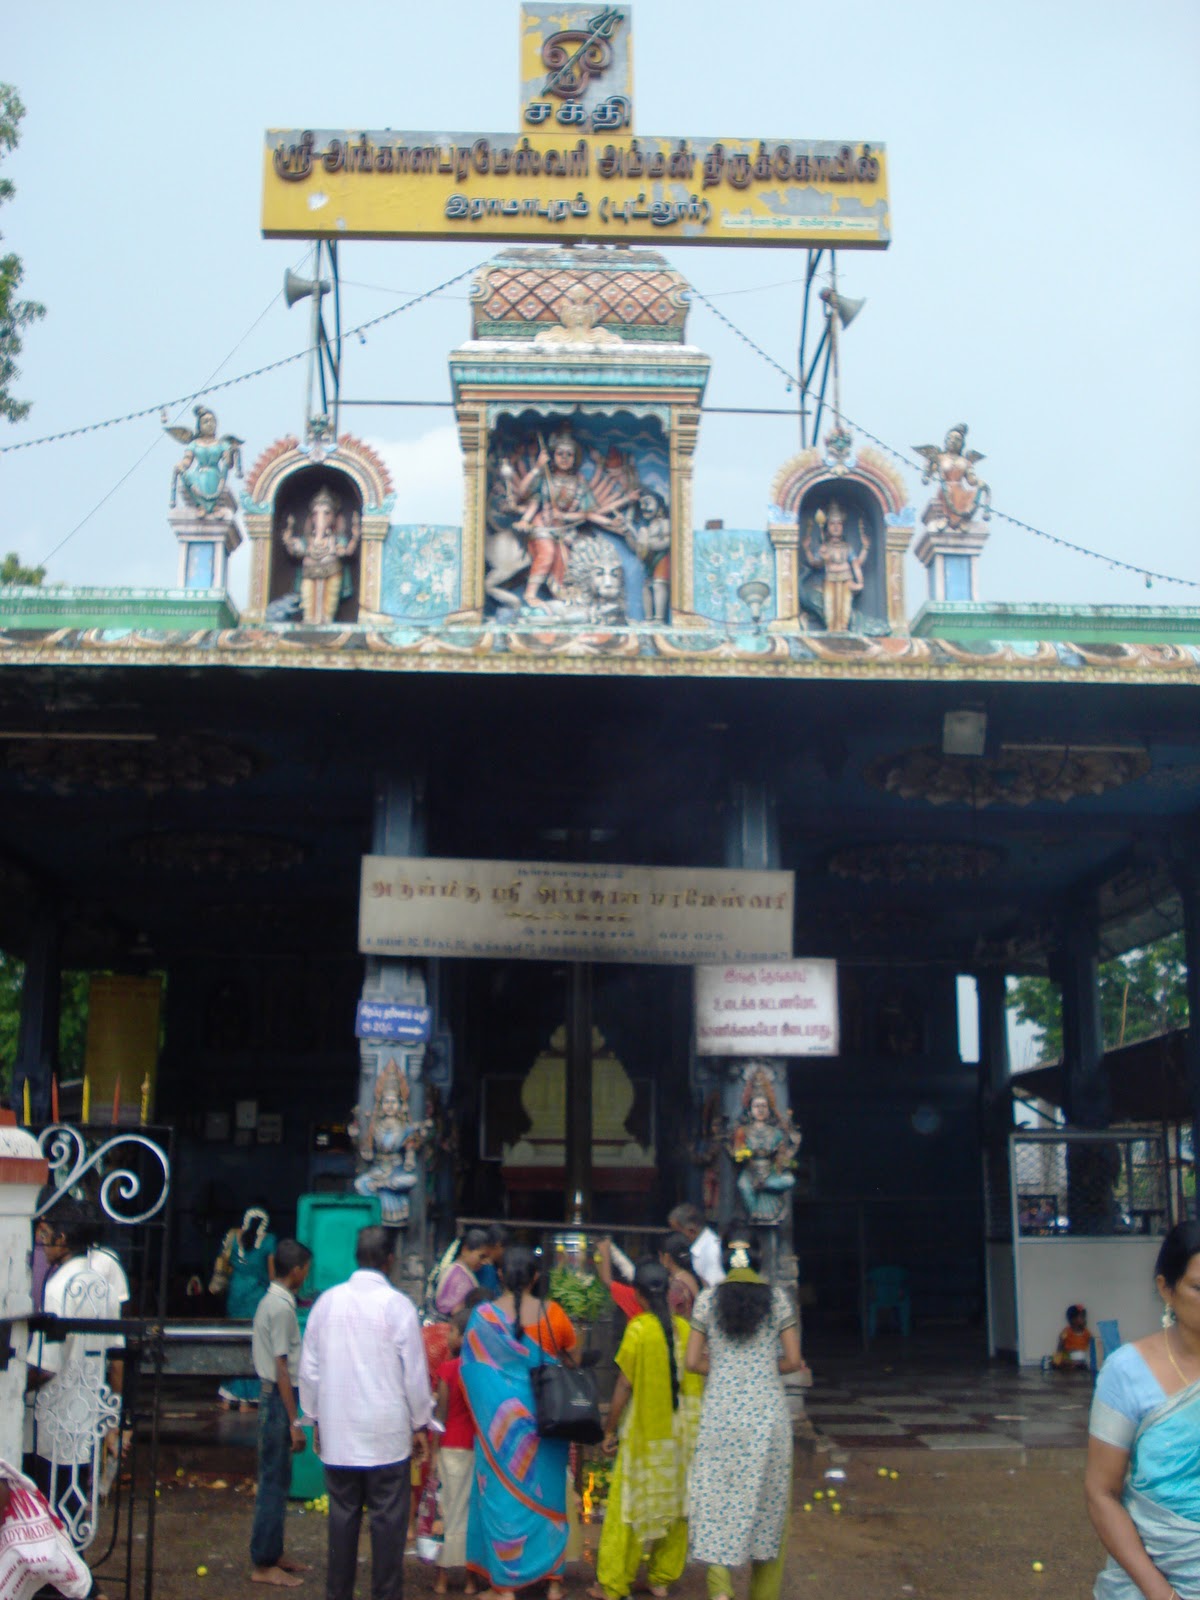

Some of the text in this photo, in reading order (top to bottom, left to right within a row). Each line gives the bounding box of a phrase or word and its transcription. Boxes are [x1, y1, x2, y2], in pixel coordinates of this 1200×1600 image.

[524, 96, 630, 132] சக்தி
[597, 139, 697, 179] அம்மன்
[702, 140, 879, 189] திருக்கோயில்
[445, 192, 589, 222] இராமாபுரம்
